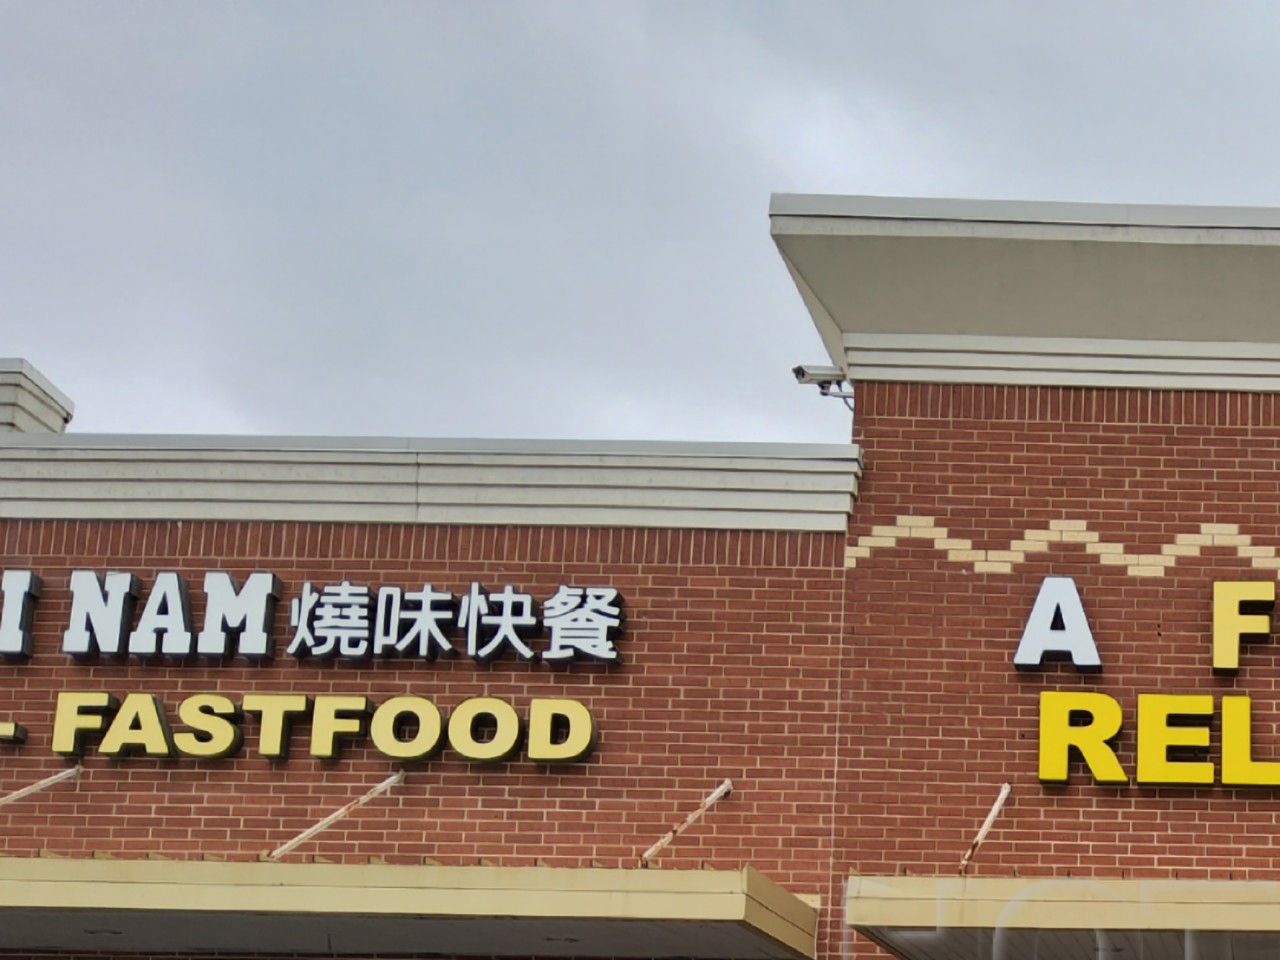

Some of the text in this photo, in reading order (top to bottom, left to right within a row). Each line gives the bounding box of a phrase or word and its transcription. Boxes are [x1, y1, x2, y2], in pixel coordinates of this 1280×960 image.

[63, 570, 272, 654] NAM
[287, 581, 621, 660] 燒味快餐
[1014, 576, 1101, 666] A
[52, 691, 594, 761] FASTFOOD
